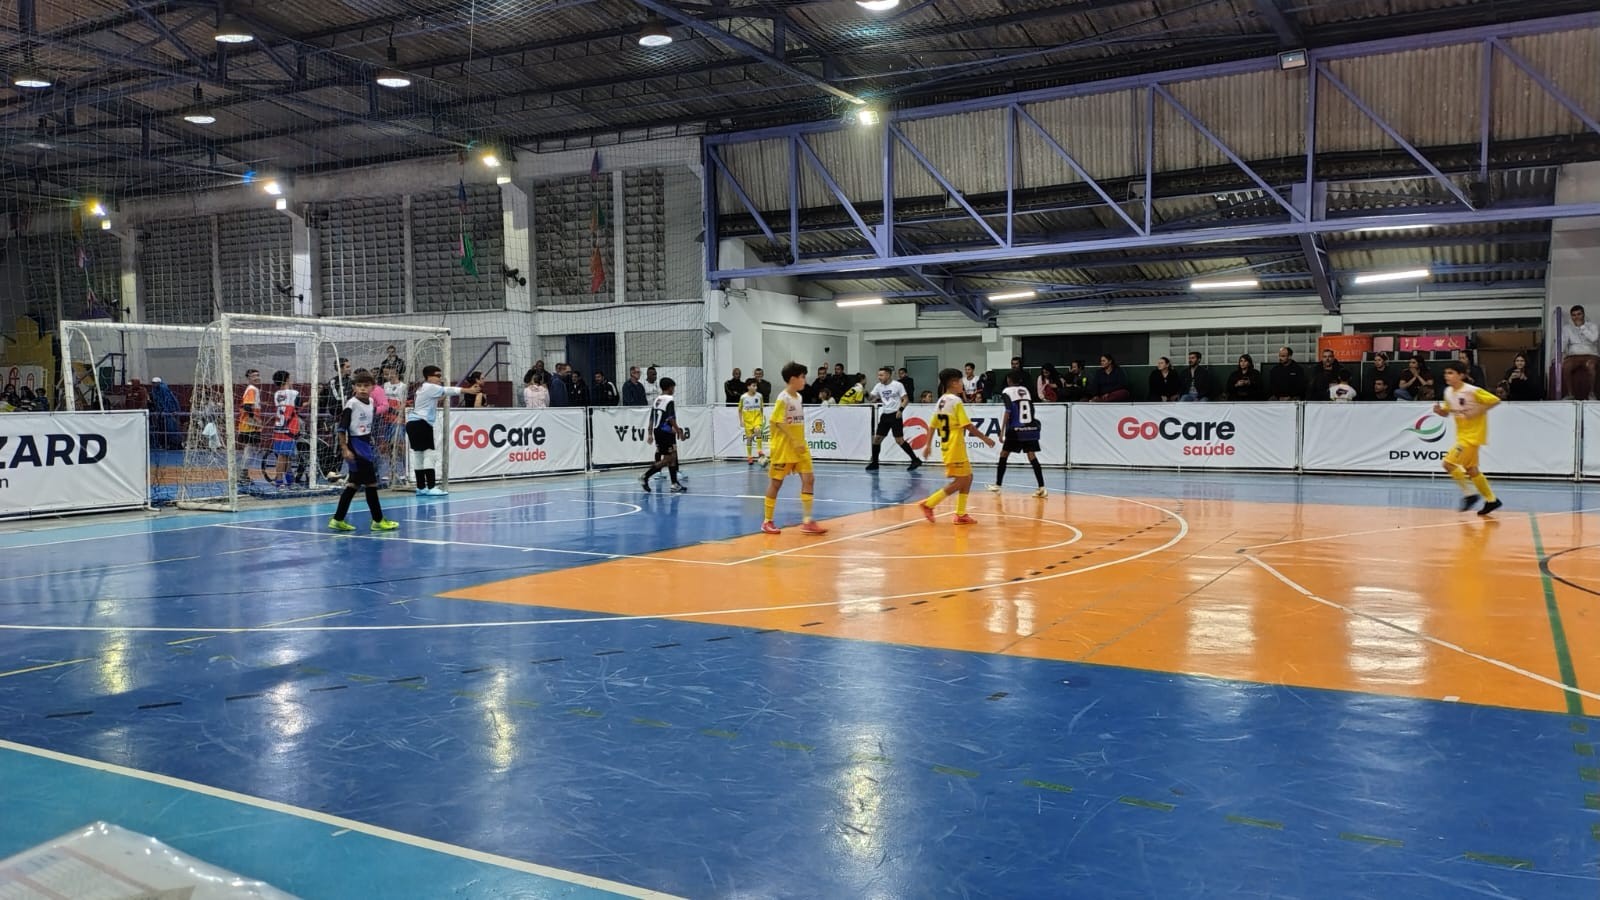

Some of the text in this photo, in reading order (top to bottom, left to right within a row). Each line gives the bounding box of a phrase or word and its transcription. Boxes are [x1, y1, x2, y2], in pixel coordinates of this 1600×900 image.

[1019, 400, 1032, 424] 8
[454, 423, 546, 450] GoCare
[937, 414, 950, 442] 3
[1117, 416, 1236, 441] GoCare
[0, 433, 107, 469] ARD
[508, 447, 547, 462] saúde
[807, 439, 837, 450] antos
[1183, 442, 1236, 456] saúde
[1389, 451, 1410, 461] DP
